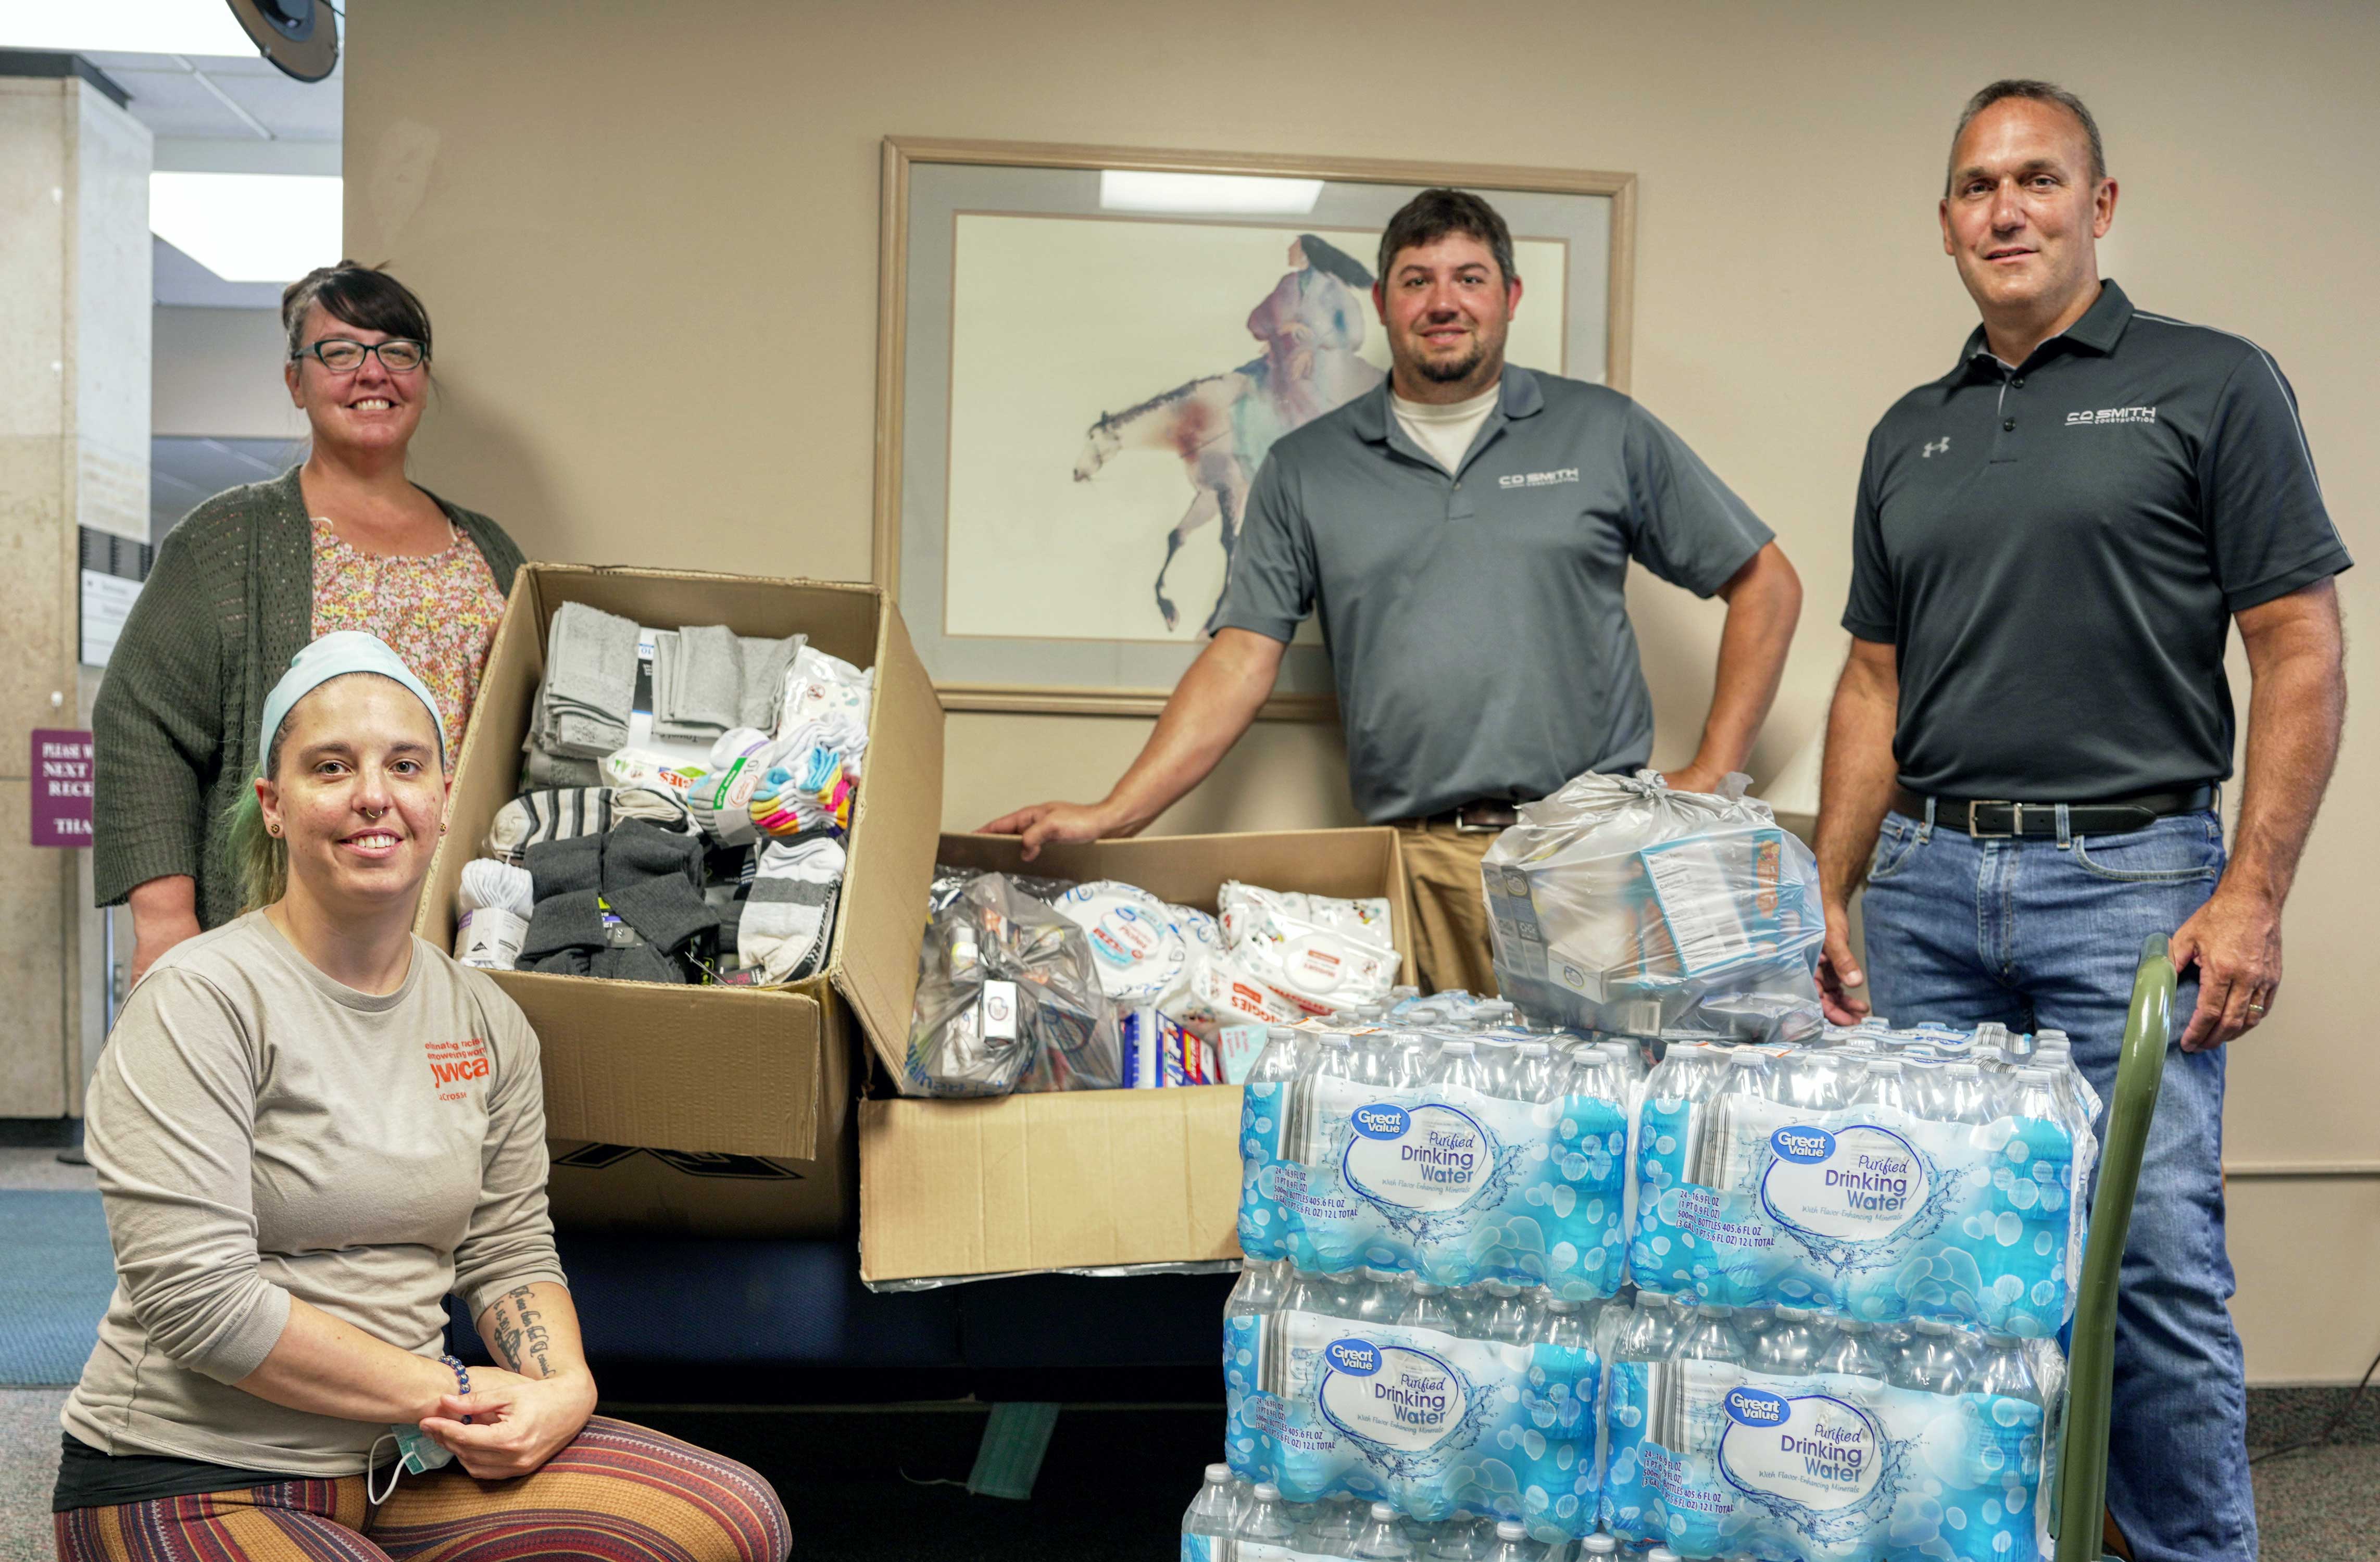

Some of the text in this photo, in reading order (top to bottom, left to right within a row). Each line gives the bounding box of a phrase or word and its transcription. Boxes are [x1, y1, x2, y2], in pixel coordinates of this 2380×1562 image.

[2096, 407, 2156, 419] SMITH
[1526, 468, 1579, 483] SMITH
[42, 742, 81, 759] PLEASE
[42, 761, 89, 777] NEXT
[430, 1057, 489, 1088] ywca
[1358, 1111, 1402, 1125] Great
[1368, 1123, 1400, 1133] Value
[1430, 1131, 1475, 1150] Purified
[1778, 1131, 1826, 1149] Great
[1401, 1145, 1473, 1170] Drinking
[1789, 1145, 1824, 1157] Value
[1421, 1164, 1473, 1183] Water
[1859, 1155, 1909, 1175] Purified
[1285, 1169, 1294, 1178] 16.9
[1294, 1170, 1299, 1179] FL
[1299, 1172, 1306, 1181] OZ
[1825, 1170, 1907, 1196] Drinking
[1274, 1185, 1288, 1198] 500mL
[1289, 1190, 1308, 1203] BOTTLES
[1309, 1197, 1326, 1207] 405.6
[1336, 1200, 1345, 1208] OZ
[1294, 1182, 1299, 1191] FL
[1299, 1183, 1308, 1193] OZ)
[1693, 1192, 1704, 1203] 16.9
[1705, 1195, 1711, 1204] FL
[1712, 1196, 1719, 1206] OZ
[1847, 1190, 1907, 1211] Water
[1291, 1201, 1296, 1210] PT
[1305, 1206, 1311, 1215] FL
[1312, 1208, 1323, 1218] OZ)
[1325, 1210, 1332, 1218] 12
[1339, 1208, 1358, 1218] TOTAL
[1678, 1200, 1720, 1219] (1 PT 0.9 FL OZ)
[1677, 1210, 1761, 1236] 500mL BOTTLES 405.6 FL OZ
[1676, 1219, 1682, 1228] (3
[1684, 1221, 1694, 1233] GAL
[1699, 1229, 1706, 1238] PT
[1706, 1232, 1715, 1241] 5.6
[1717, 1234, 1724, 1243] FL
[1726, 1235, 1737, 1246] OZ)
[1739, 1237, 1747, 1246] 12
[1755, 1237, 1775, 1248] TOTAL
[1332, 1345, 1374, 1362] Great
[1342, 1358, 1372, 1370] Value
[1401, 1374, 1446, 1392] Purified
[1375, 1383, 1445, 1412] Drinking
[1731, 1393, 1780, 1414] Great
[1394, 1404, 1446, 1425] Water
[1743, 1408, 1779, 1421] Value
[1256, 1414, 1269, 1425] 500mL
[1270, 1418, 1287, 1432] BOTTLES
[1288, 1428, 1305, 1438] 405.6
[1815, 1424, 1862, 1444] Purified
[1284, 1435, 1290, 1444] FL
[1291, 1439, 1301, 1449] OZ)
[1303, 1441, 1310, 1450] 12
[1317, 1441, 1336, 1450] TOTAL
[1781, 1435, 1862, 1468] Drinking
[1657, 1453, 1667, 1466] 16.9
[1668, 1461, 1673, 1470] FL
[1674, 1462, 1682, 1472] OZ
[1805, 1457, 1862, 1482] Water
[1651, 1461, 1658, 1469] PT
[1658, 1464, 1667, 1477] 0.9
[1668, 1471, 1673, 1481] FL
[1674, 1473, 1682, 1484] OZ)
[1643, 1469, 1721, 1502] 500mL BOTTLES 405.6 FL OZ
[1832, 1484, 1859, 1493] Minerals
[1642, 1478, 1648, 1487] (3
[1649, 1479, 1660, 1490] GAL
[1665, 1492, 1670, 1502] PT
[1678, 1498, 1685, 1507] FL
[1686, 1500, 1698, 1510] OZ)
[1700, 1503, 1708, 1511] 12
[1715, 1504, 1734, 1514] TOTAL
